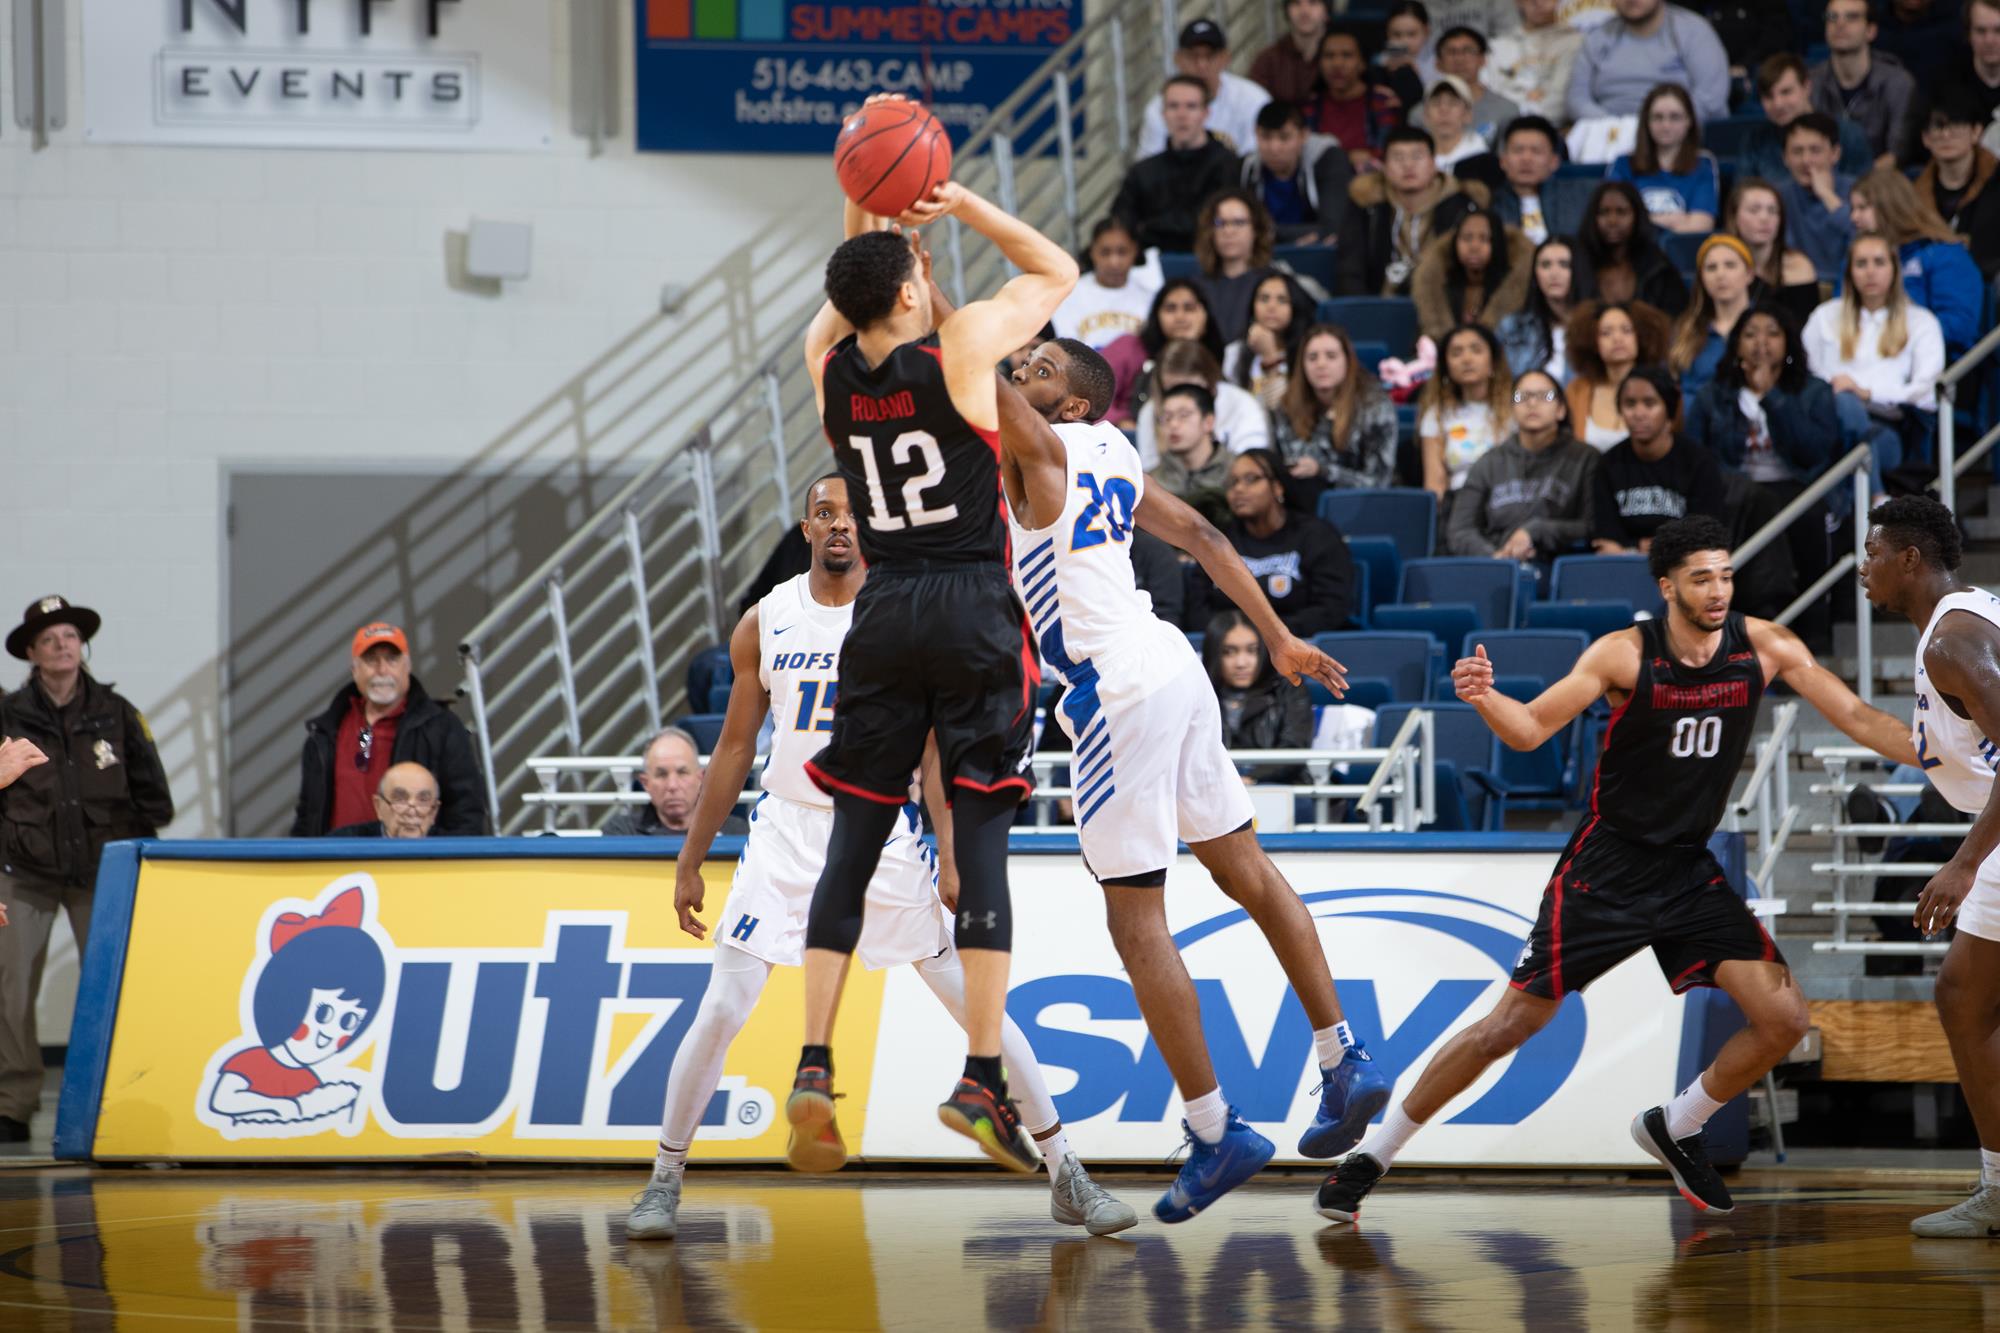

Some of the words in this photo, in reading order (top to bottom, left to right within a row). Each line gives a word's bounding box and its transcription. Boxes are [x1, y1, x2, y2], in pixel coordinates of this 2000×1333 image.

[791, 5, 944, 41] SUMMER
[950, 9, 1072, 44] CAMPS
[181, 67, 462, 101] EVENTS
[752, 57, 973, 92] 516-463-CAMP
[850, 389, 916, 422] ROLAND
[848, 429, 959, 531] 12
[1068, 471, 1137, 553] 20
[773, 652, 836, 671] HOFS
[1651, 680, 1748, 710] NORTHEASTERN
[1671, 715, 1723, 758] 00
[731, 912, 761, 943] H
[1005, 974, 1495, 1124] SNY
